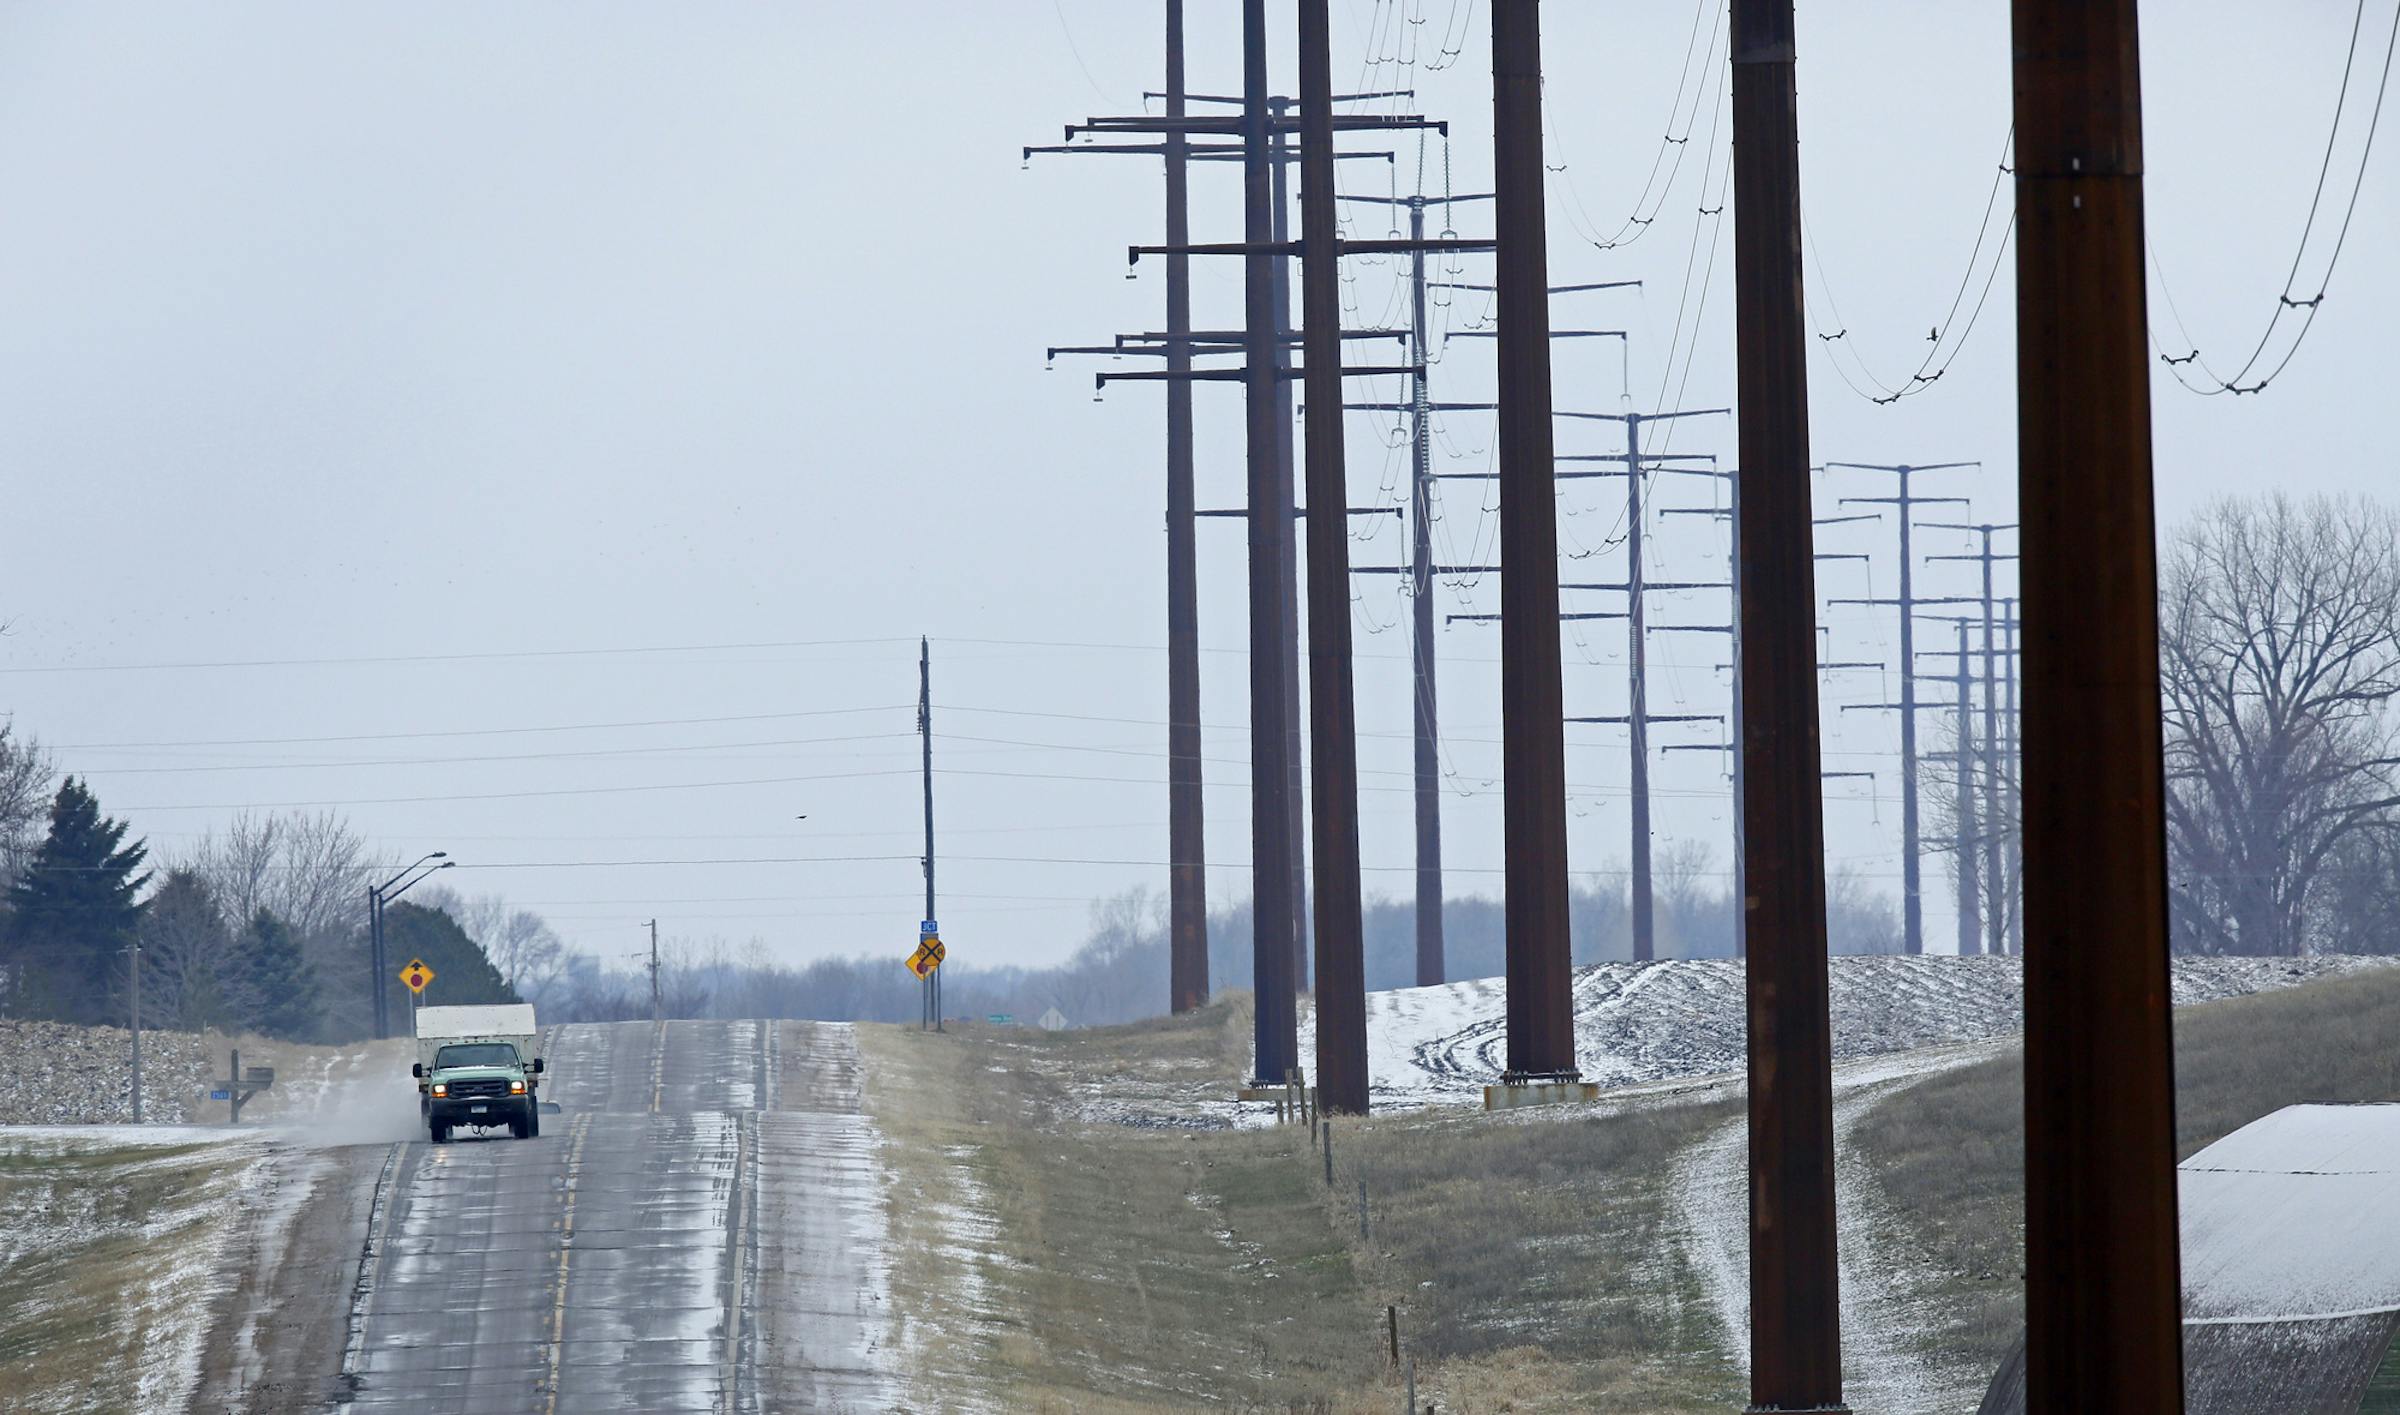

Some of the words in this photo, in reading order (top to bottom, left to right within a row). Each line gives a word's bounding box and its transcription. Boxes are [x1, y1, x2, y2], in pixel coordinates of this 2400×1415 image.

[922, 922, 936, 931] JCT
[919, 948, 925, 956] R
[937, 948, 943, 956] R
